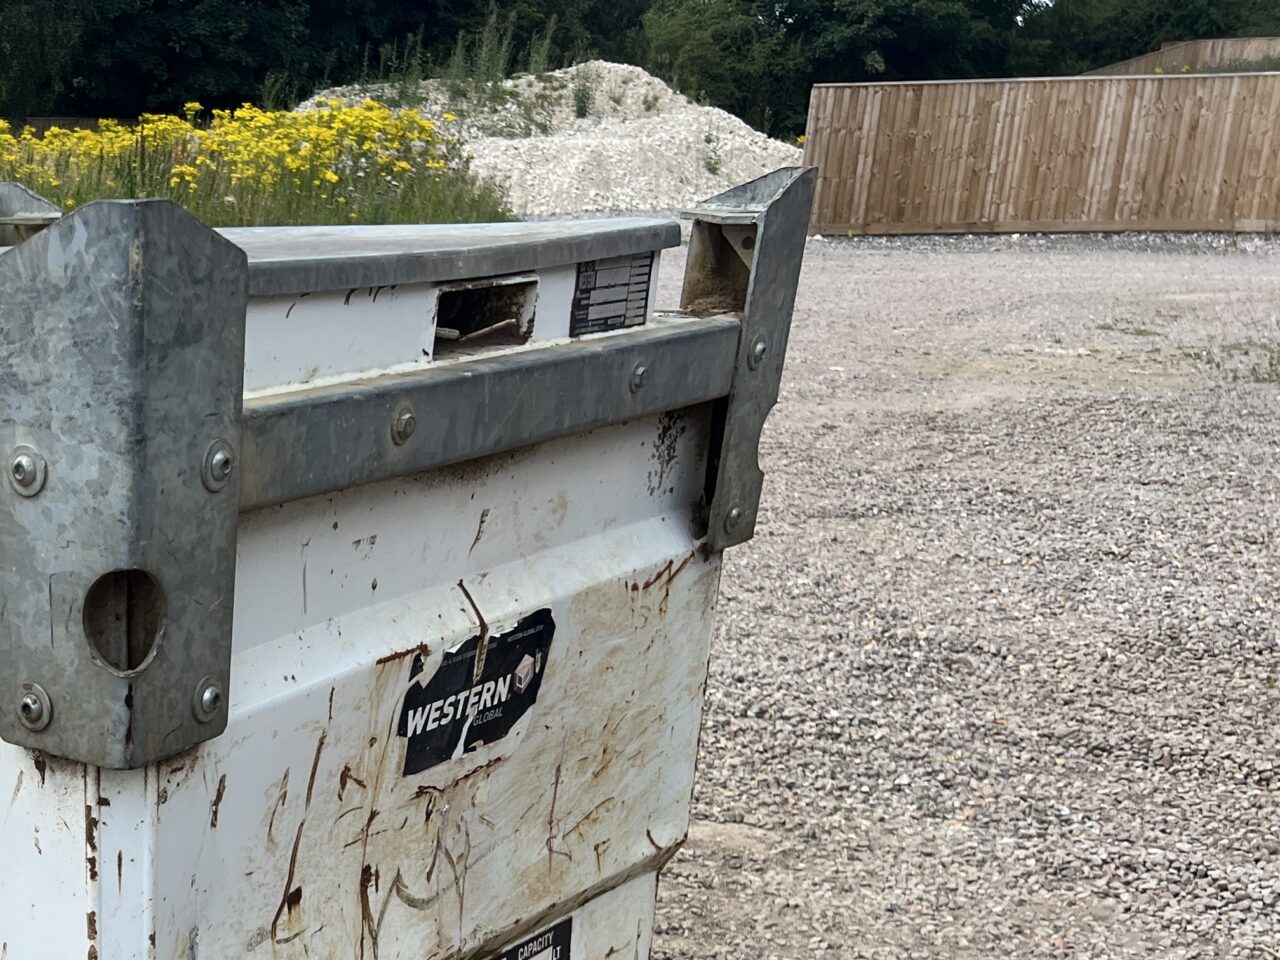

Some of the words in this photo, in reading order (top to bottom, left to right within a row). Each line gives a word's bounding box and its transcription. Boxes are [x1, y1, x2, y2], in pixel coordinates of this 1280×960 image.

[407, 673, 512, 738] WESTERN
[473, 707, 503, 726] GLOBAL
[518, 930, 554, 960] CAPACITY
